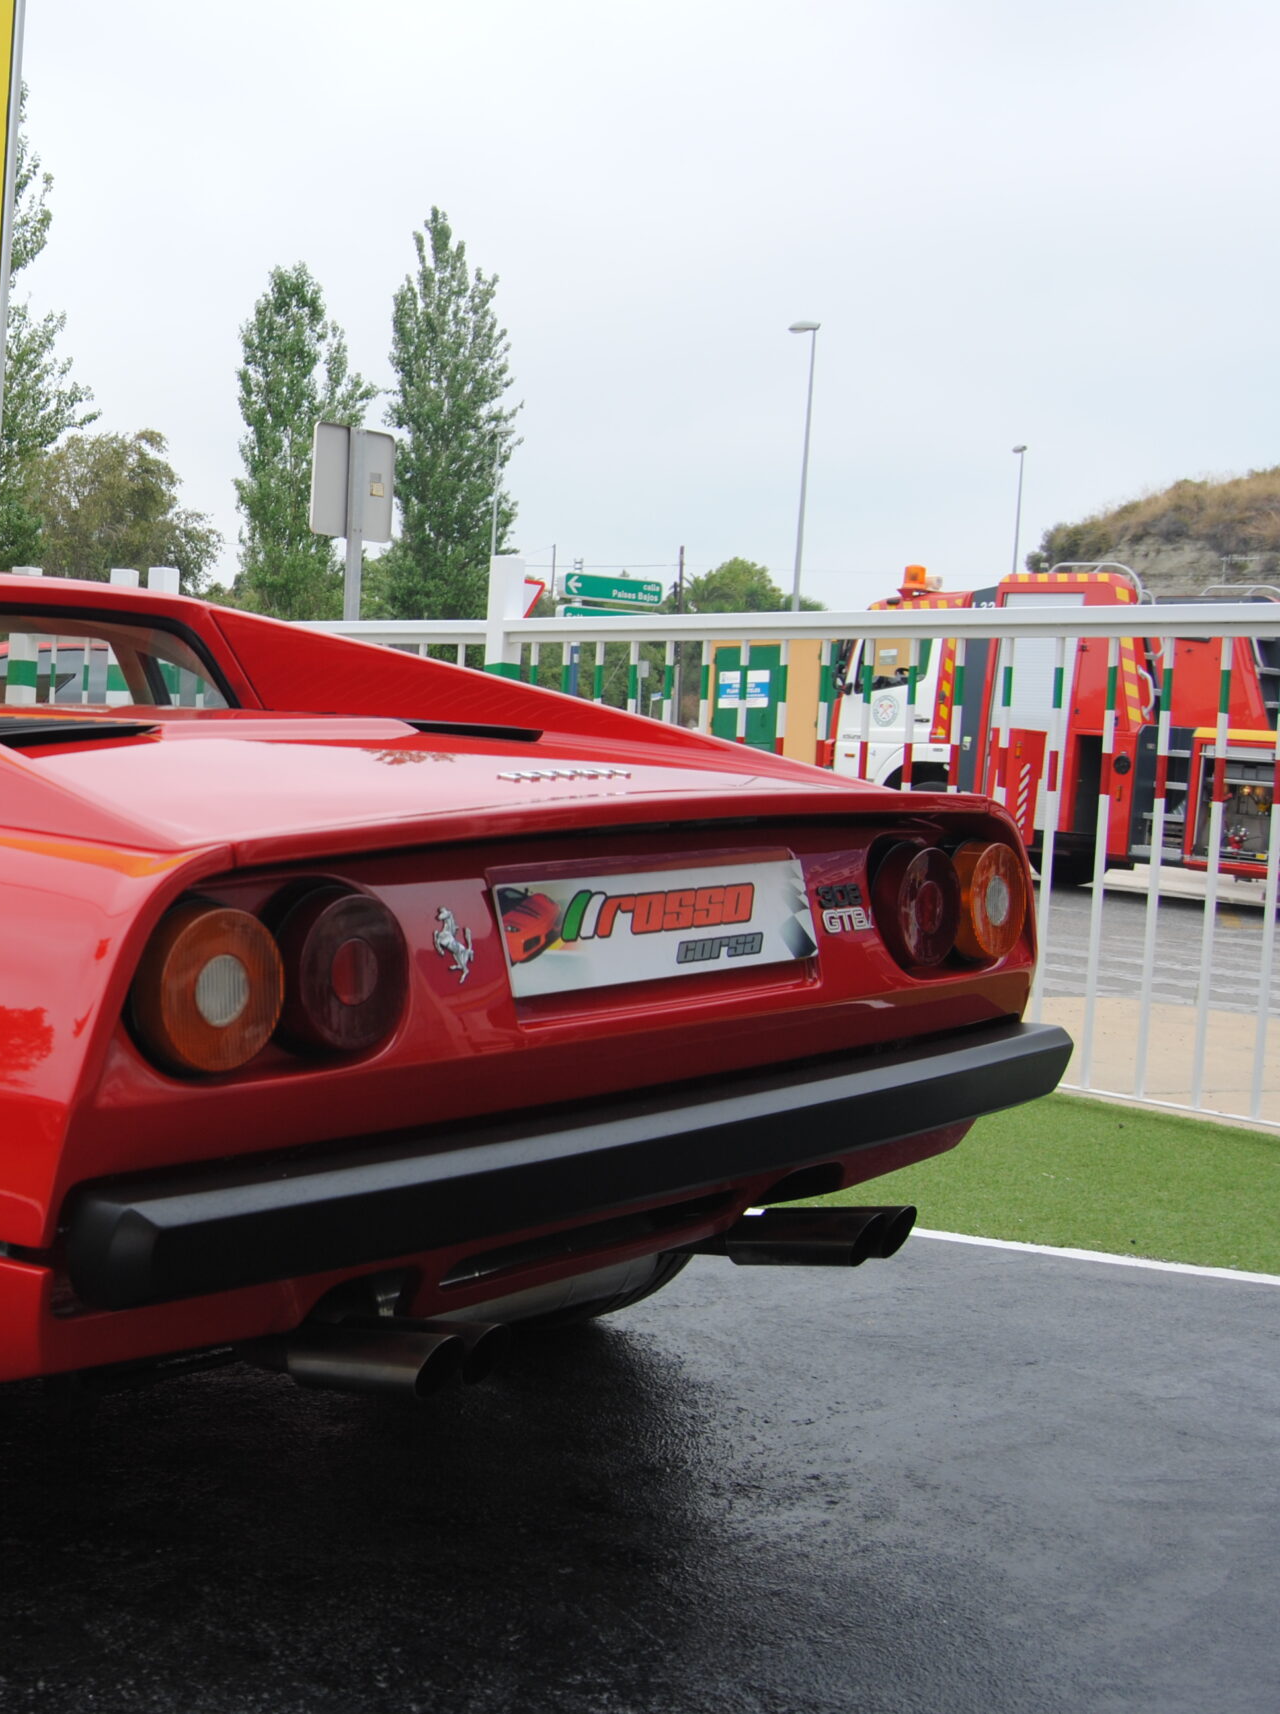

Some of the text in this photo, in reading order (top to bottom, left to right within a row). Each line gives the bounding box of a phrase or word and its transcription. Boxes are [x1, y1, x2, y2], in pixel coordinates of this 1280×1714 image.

[638, 591, 658, 603] Bajos
[596, 882, 756, 939] rosso
[817, 883, 863, 909] 308
[675, 931, 764, 965] corsa
